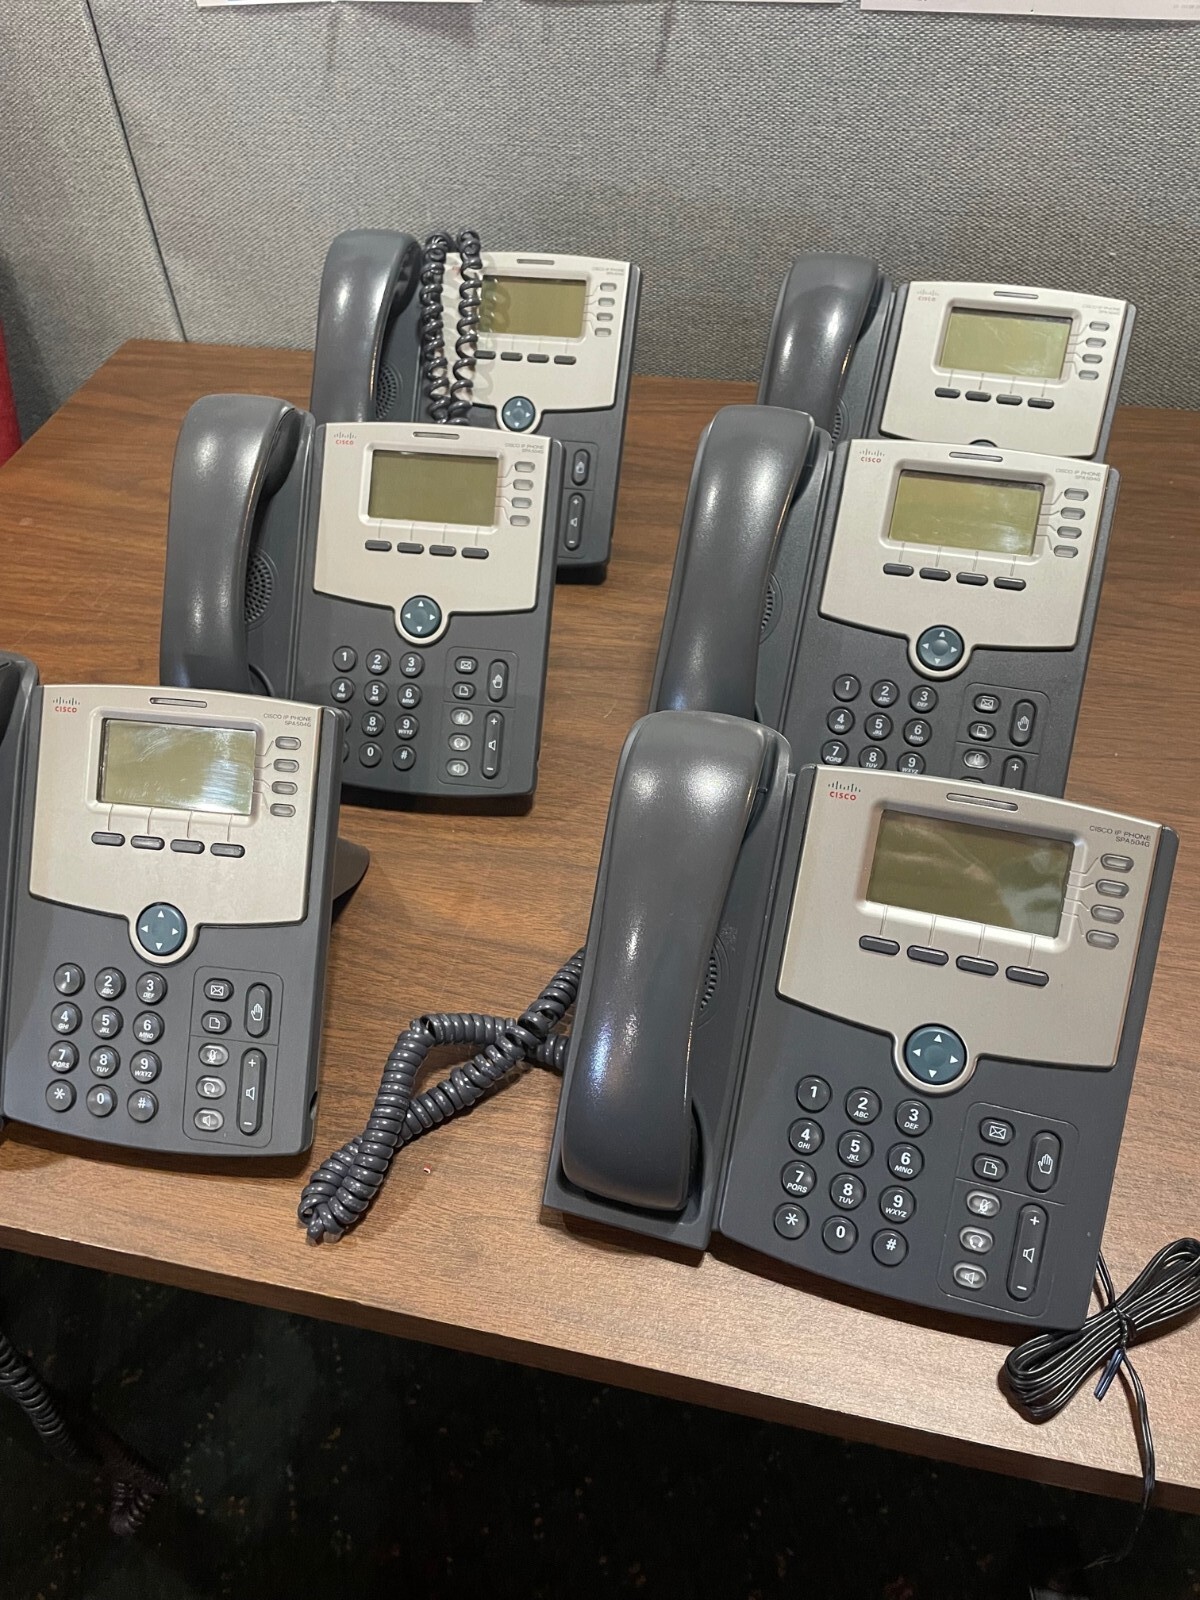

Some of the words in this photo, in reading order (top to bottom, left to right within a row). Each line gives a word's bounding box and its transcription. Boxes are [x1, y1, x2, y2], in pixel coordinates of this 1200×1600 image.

[342, 652, 347, 661] 1
[374, 655, 380, 663] 2
[408, 657, 415, 666] 3
[338, 683, 345, 692] 4
[372, 686, 378, 694] 5
[844, 681, 849, 690] 1
[881, 686, 889, 695] 2
[406, 689, 412, 698] 6
[920, 691, 928, 701] 3
[369, 717, 376, 726] 8
[837, 713, 844, 723] 4
[403, 719, 410, 728] 9
[875, 719, 882, 729] 5
[914, 724, 922, 734] 6
[367, 747, 374, 756] 0
[832, 746, 839, 756] 7
[869, 751, 877, 762] 8
[908, 757, 915, 768] 9
[830, 792, 856, 800] CISCO
[1090, 826, 1112, 834] CISCO
[1124, 832, 1151, 841] PHONE
[1116, 836, 1150, 847] SPA504G
[64, 972, 70, 982] 1
[104, 976, 112, 987] 2
[146, 980, 154, 991] 3
[61, 1011, 68, 1022] 4
[102, 1015, 109, 1026] 5
[143, 1020, 151, 1031] 6
[58, 1050, 65, 1060] 7
[100, 1054, 107, 1065] 8
[140, 1058, 148, 1069] 9
[810, 1086, 817, 1098] 1
[97, 1093, 104, 1104] 0
[138, 1097, 146, 1108] #
[858, 1098, 868, 1110] 2
[854, 1111, 869, 1119] ABC
[909, 1109, 919, 1121] 3
[904, 1121, 919, 1130] DEF
[801, 1129, 810, 1141] 4
[798, 1141, 810, 1149] GHI
[851, 1140, 860, 1152] 5
[847, 1153, 859, 1162] JKL
[901, 1152, 911, 1164] 6
[895, 1165, 913, 1174] MNO
[795, 1171, 804, 1183] 7
[787, 1183, 807, 1192] PQRS
[843, 1183, 853, 1195] 8
[839, 1196, 854, 1204] TUV
[893, 1195, 903, 1207] 9
[885, 1208, 907, 1217] WXYZ
[836, 1226, 845, 1238] 0
[886, 1238, 896, 1250] #
